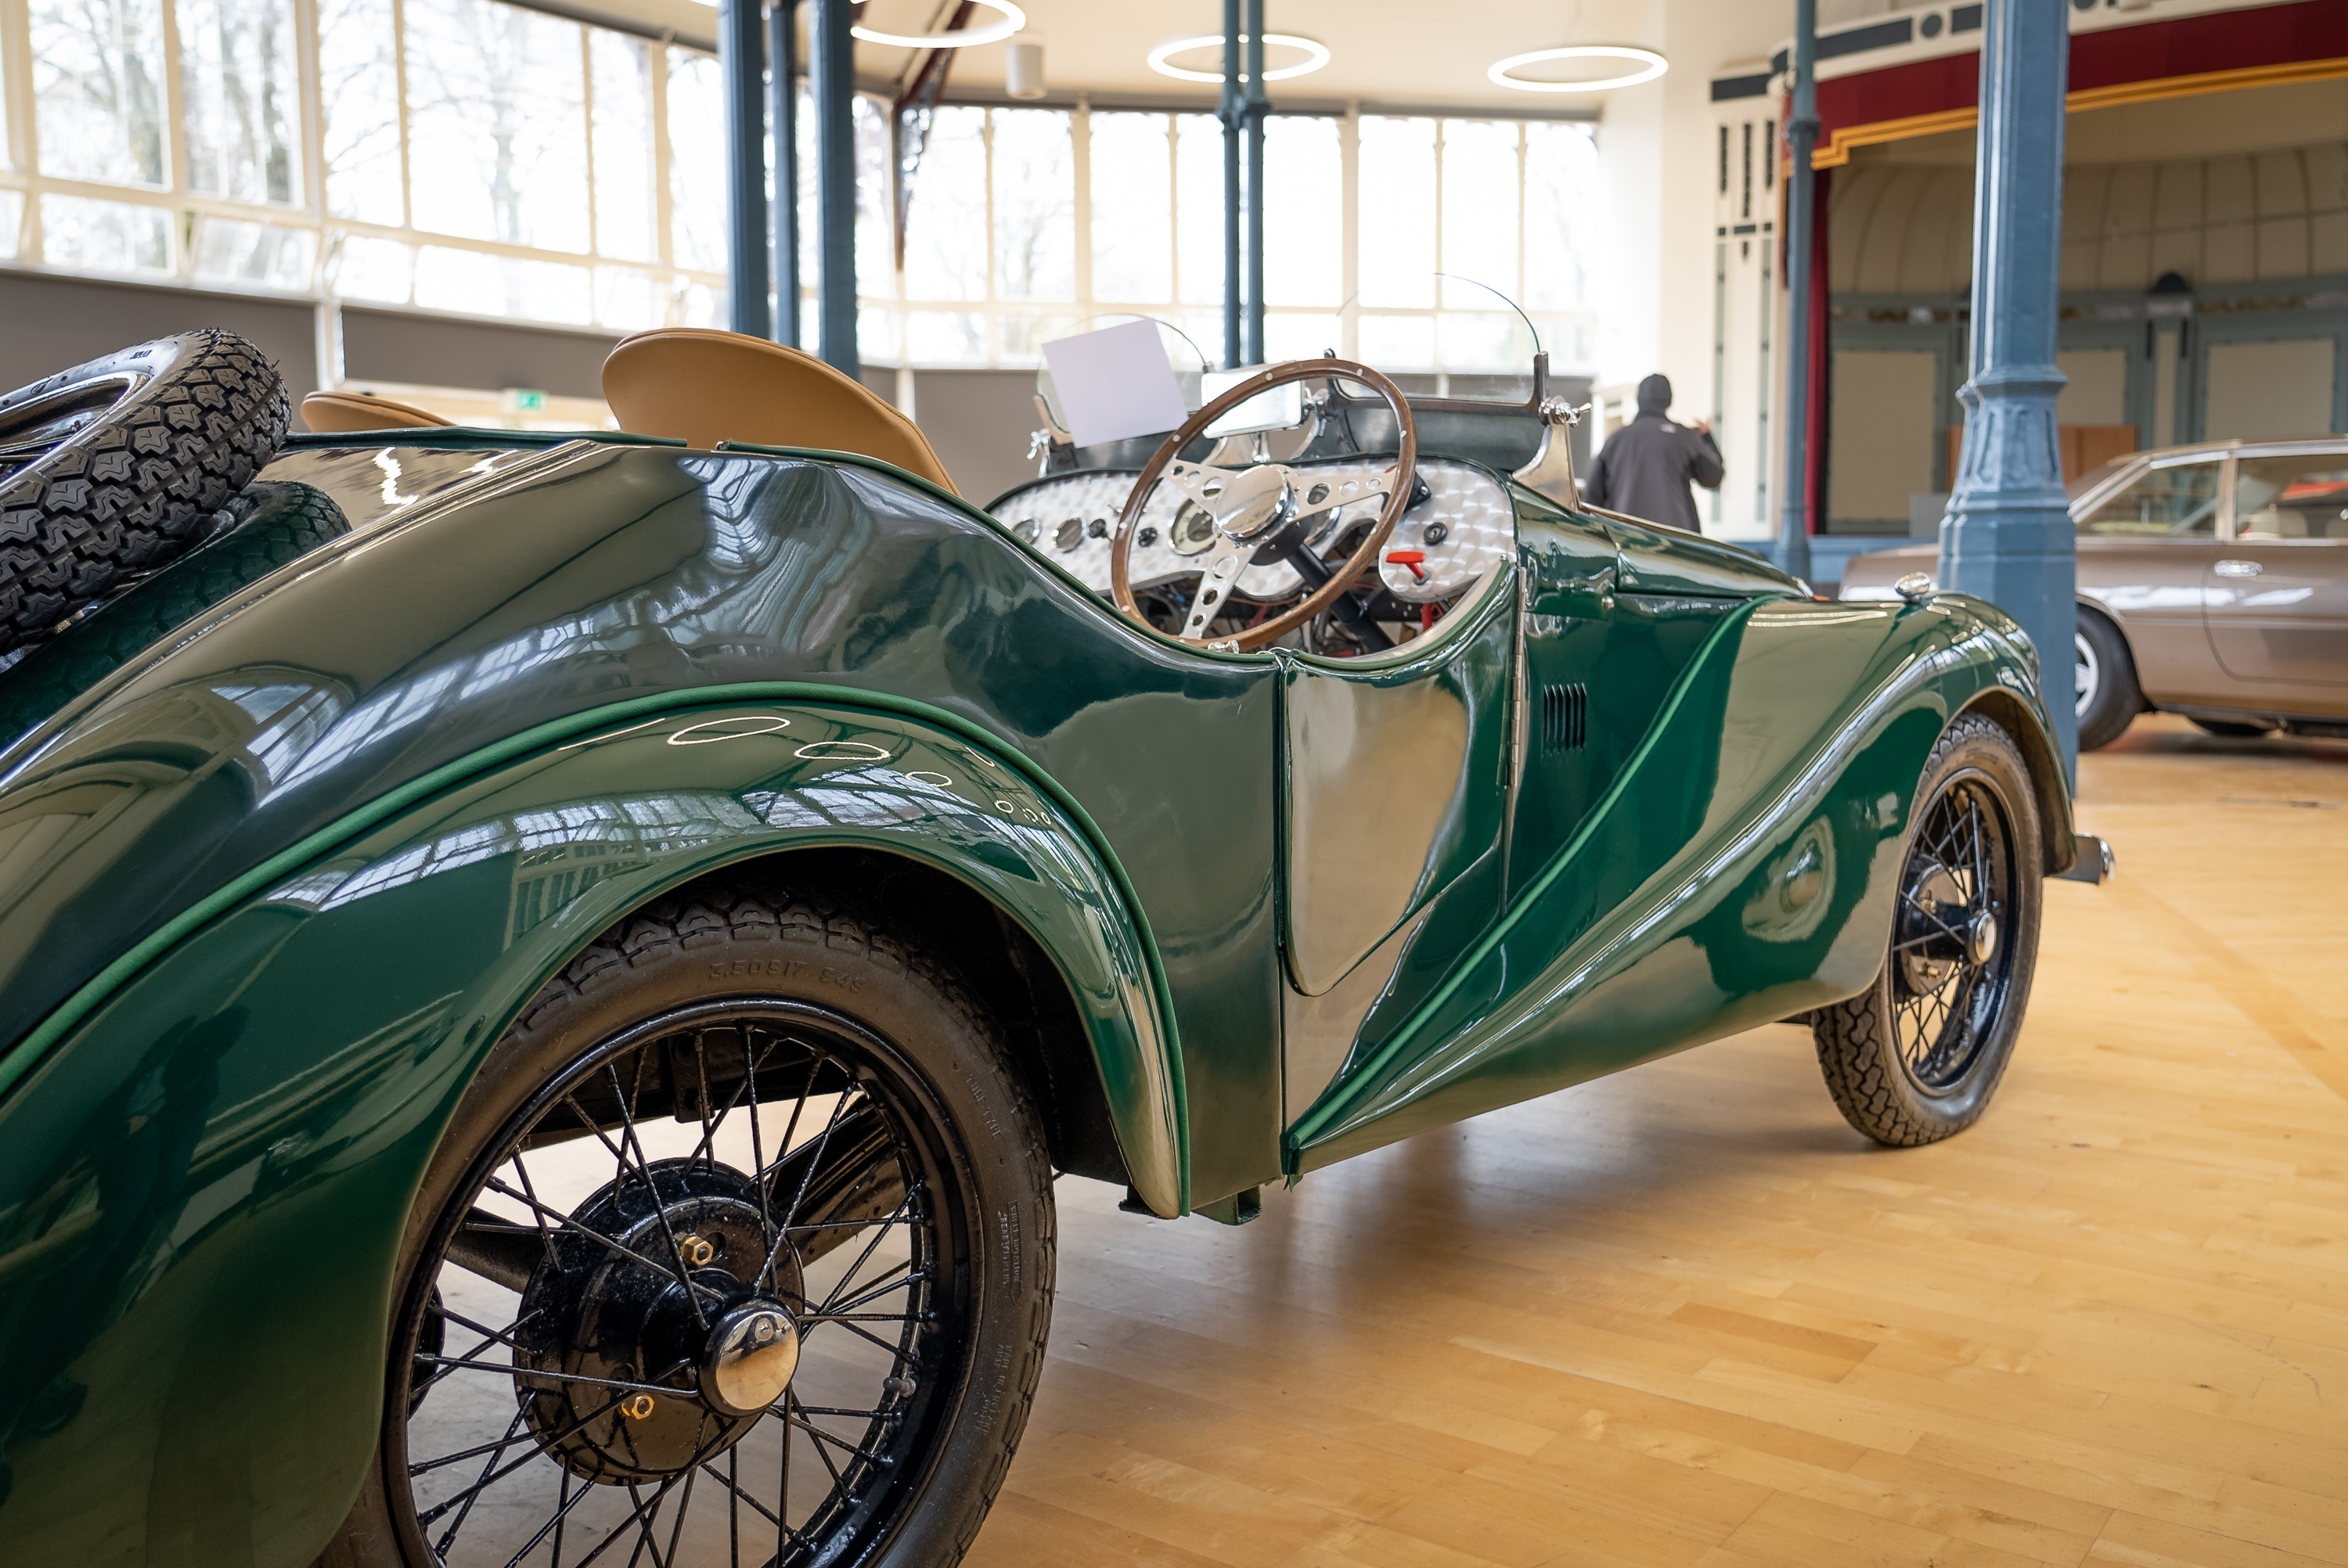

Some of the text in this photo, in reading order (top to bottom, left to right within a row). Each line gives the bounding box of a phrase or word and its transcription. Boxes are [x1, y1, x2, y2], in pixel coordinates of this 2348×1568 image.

[965, 1074, 1002, 1141] TUBE TYPE
[1010, 1206, 1019, 1232] WHEEL
[1001, 1345, 1013, 1370] MADE
[996, 1375, 1006, 1386] IN
[982, 1389, 1002, 1435] ENGLAND
